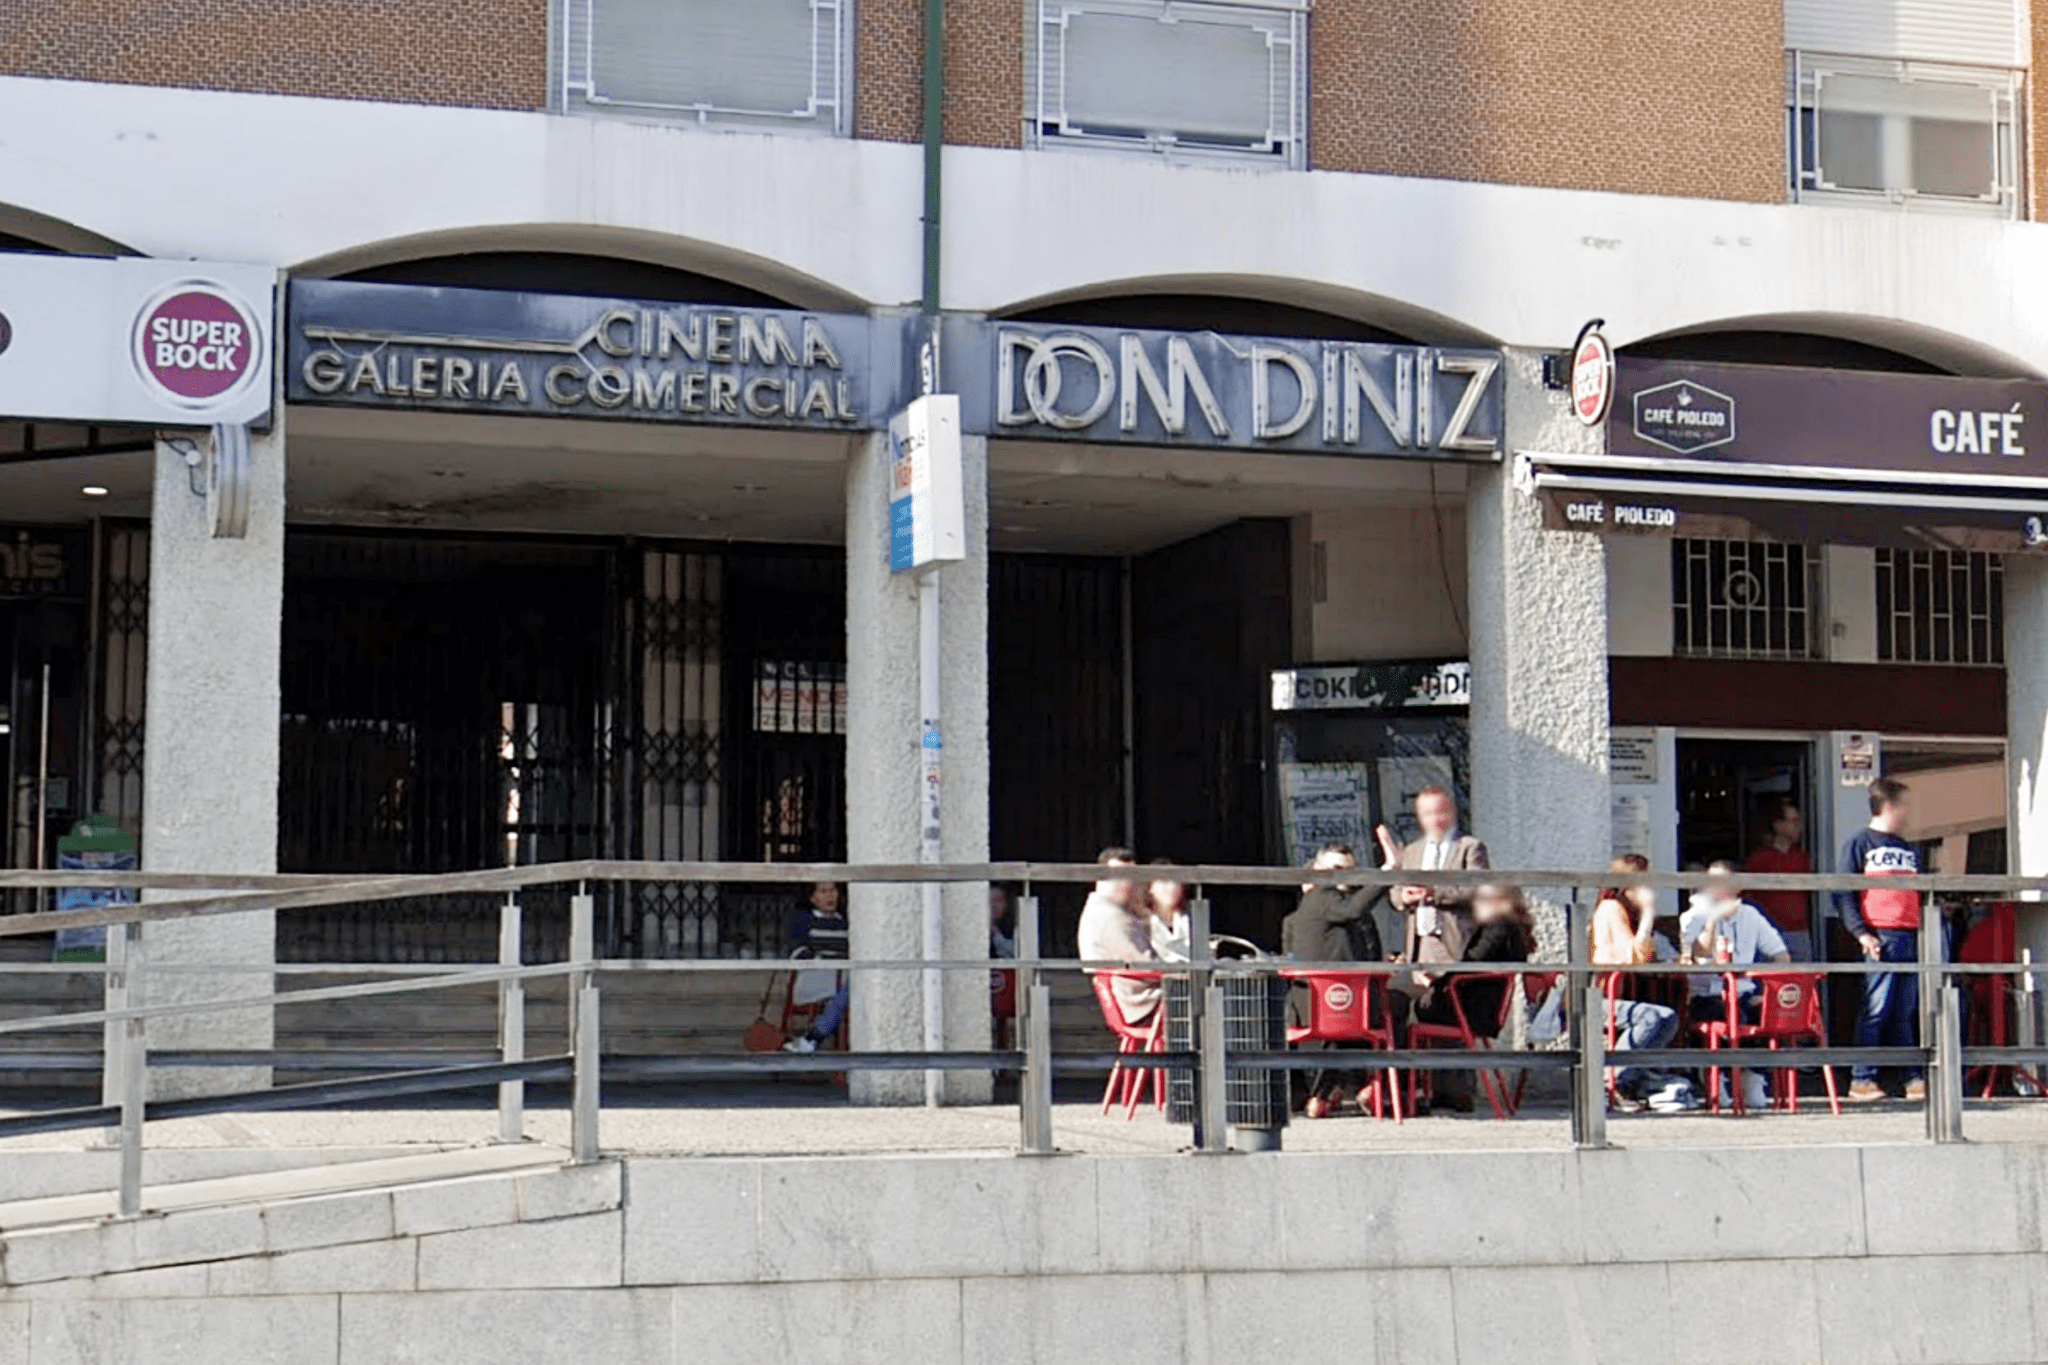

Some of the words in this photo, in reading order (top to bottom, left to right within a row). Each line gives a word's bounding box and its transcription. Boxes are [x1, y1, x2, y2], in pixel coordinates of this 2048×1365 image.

[152, 317, 242, 347] SUPER
[597, 309, 841, 369] CINEMA
[155, 342, 238, 372] BOCK
[302, 350, 529, 401] GALERIA
[544, 363, 859, 421] COMERCIAL
[997, 329, 1232, 438] DOM
[1252, 343, 1502, 452] DINIZ
[1644, 406, 1674, 425] CAFÉ
[1676, 410, 1726, 427] PIOLEDO
[1931, 401, 2025, 456] CAFÉ
[1566, 500, 1604, 523] CAFÉ
[1614, 505, 1676, 526] PIOLEDO
